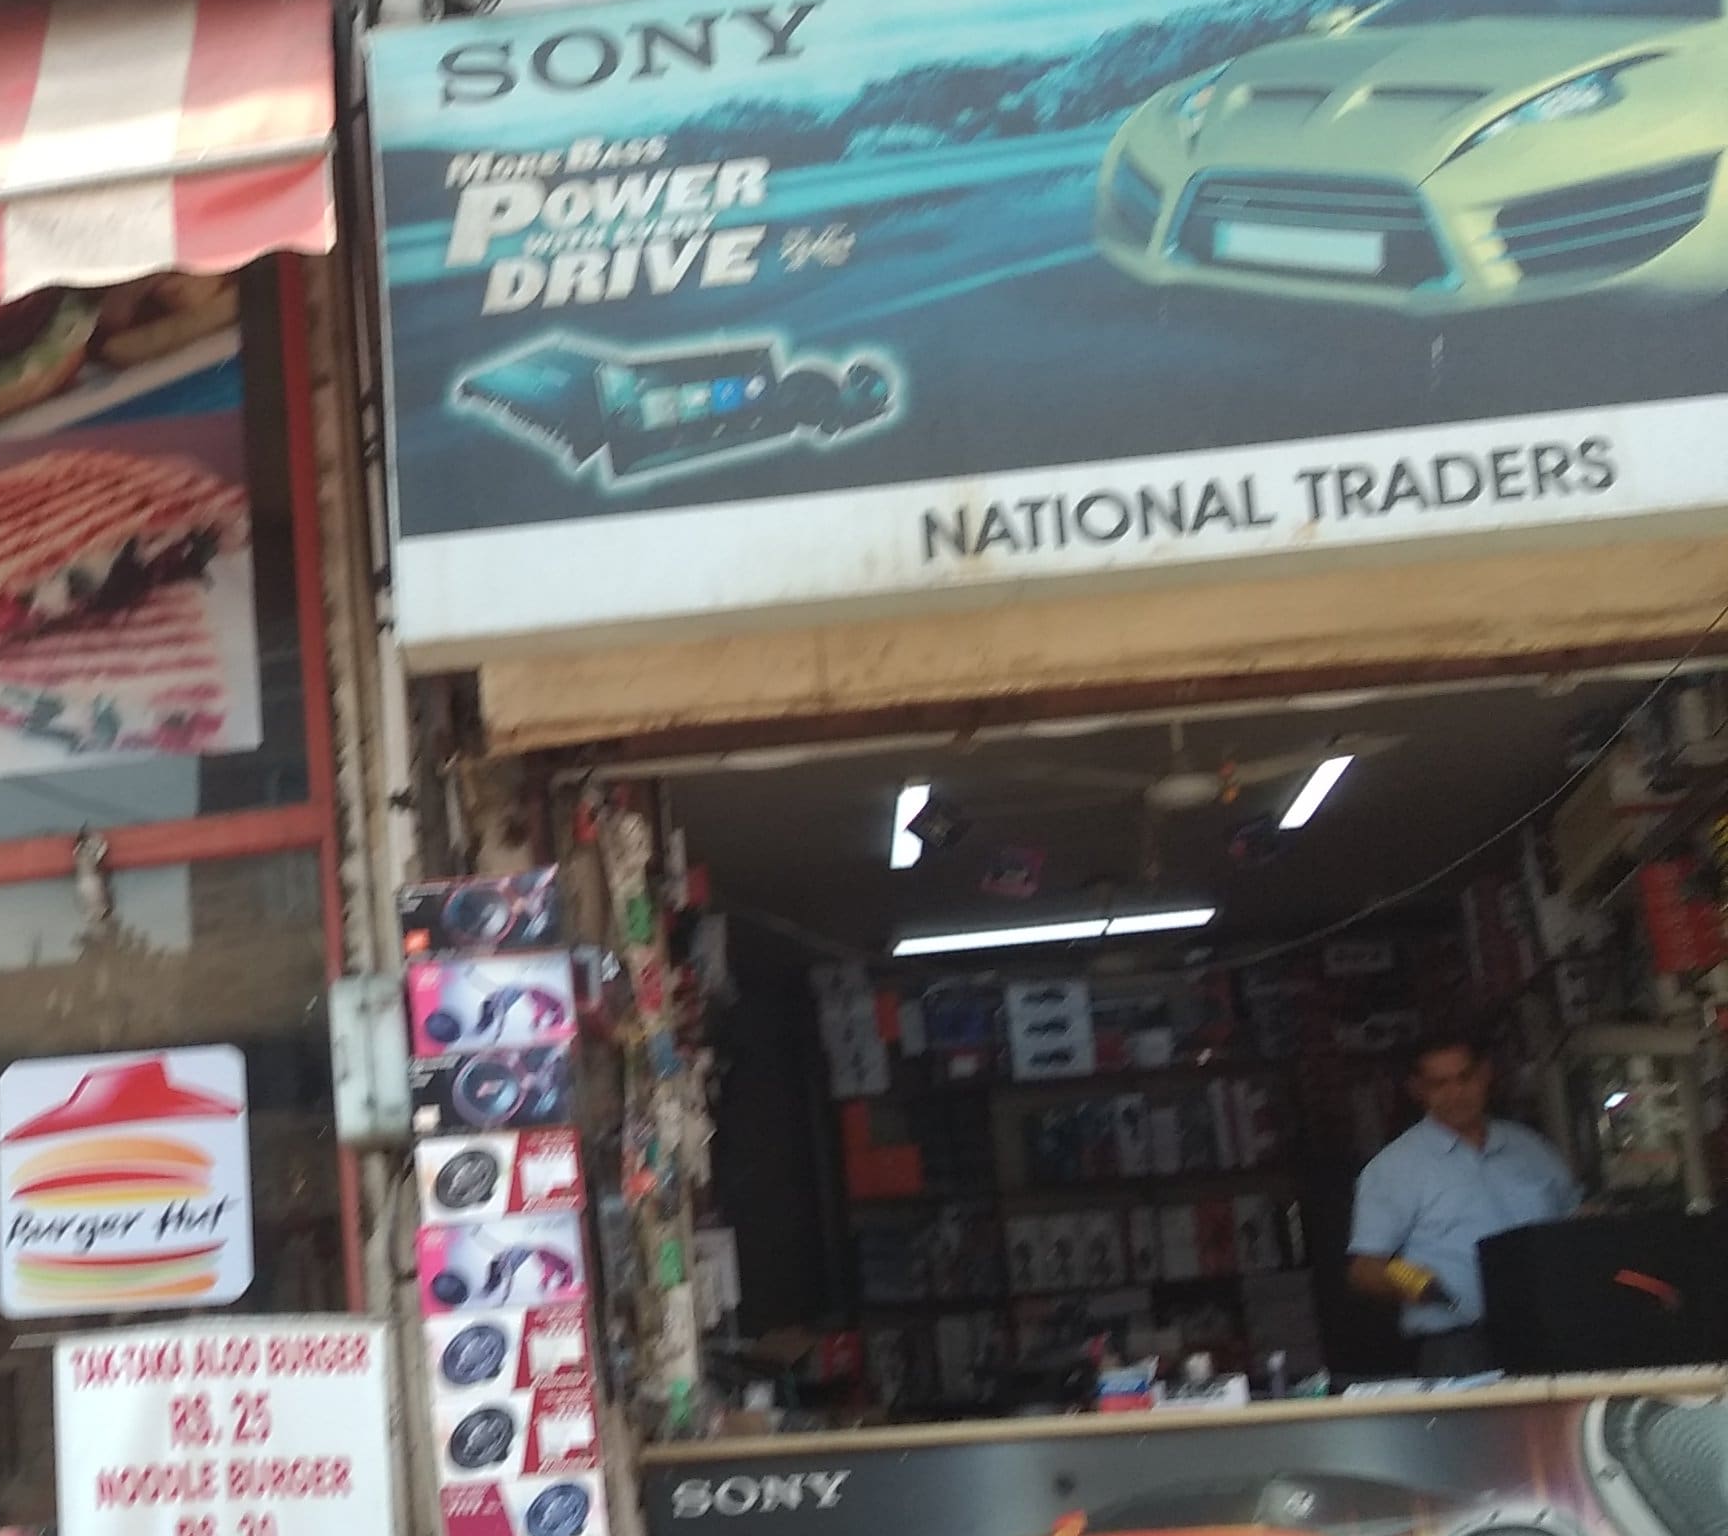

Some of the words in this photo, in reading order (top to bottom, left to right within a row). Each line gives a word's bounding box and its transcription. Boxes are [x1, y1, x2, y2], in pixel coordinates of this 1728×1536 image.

[445, 156, 771, 268] POWER
[481, 225, 767, 316] DRIVE
[922, 475, 1277, 564] NATIONAL
[1297, 437, 1618, 524] TRADERS
[265, 1331, 371, 1378] BURGER
[230, 1390, 272, 1446] 25
[95, 1457, 219, 1510] NOODLE
[226, 1456, 352, 1501] BURGER
[672, 1470, 851, 1518] SONY
